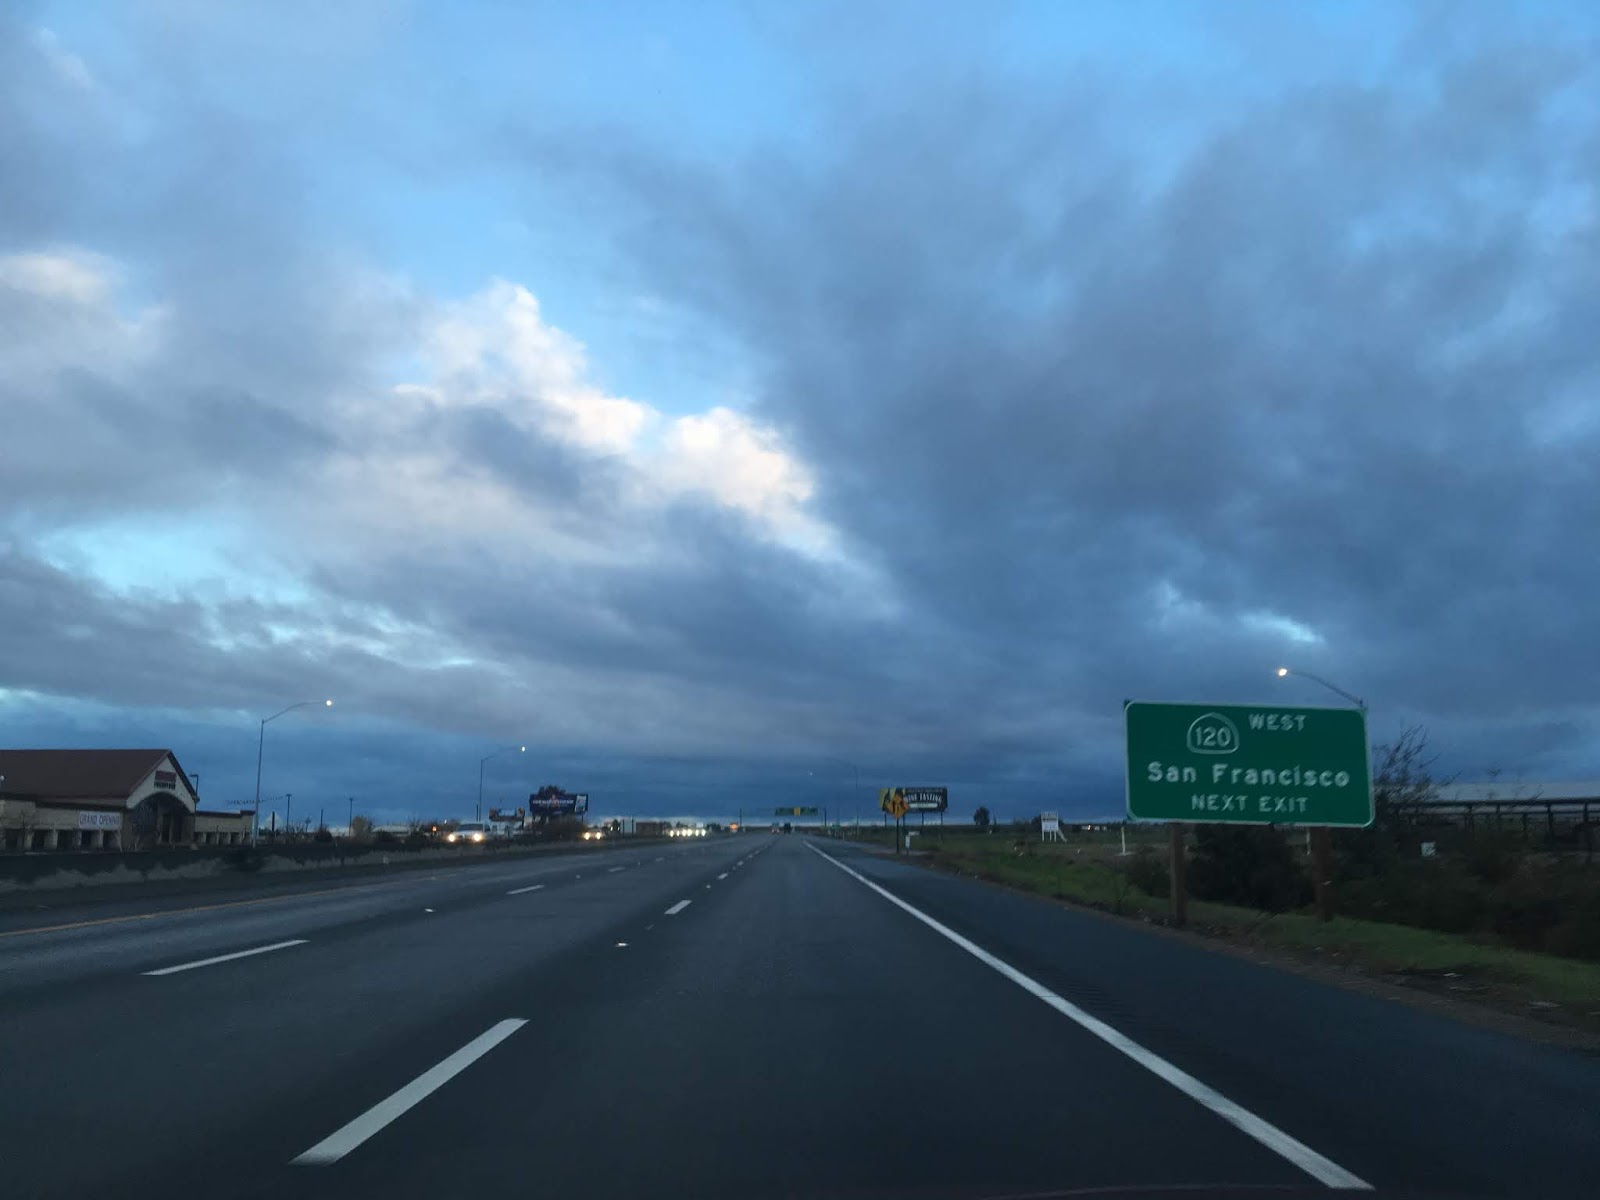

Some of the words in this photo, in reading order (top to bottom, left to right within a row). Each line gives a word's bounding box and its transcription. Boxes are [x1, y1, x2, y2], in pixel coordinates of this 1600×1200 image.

[1249, 714, 1306, 731] WEST
[1195, 726, 1232, 747] 120
[1147, 761, 1197, 783] San
[1212, 763, 1350, 787] Francisco
[1191, 795, 1248, 811] NEXT
[1259, 796, 1309, 813] EXIT
